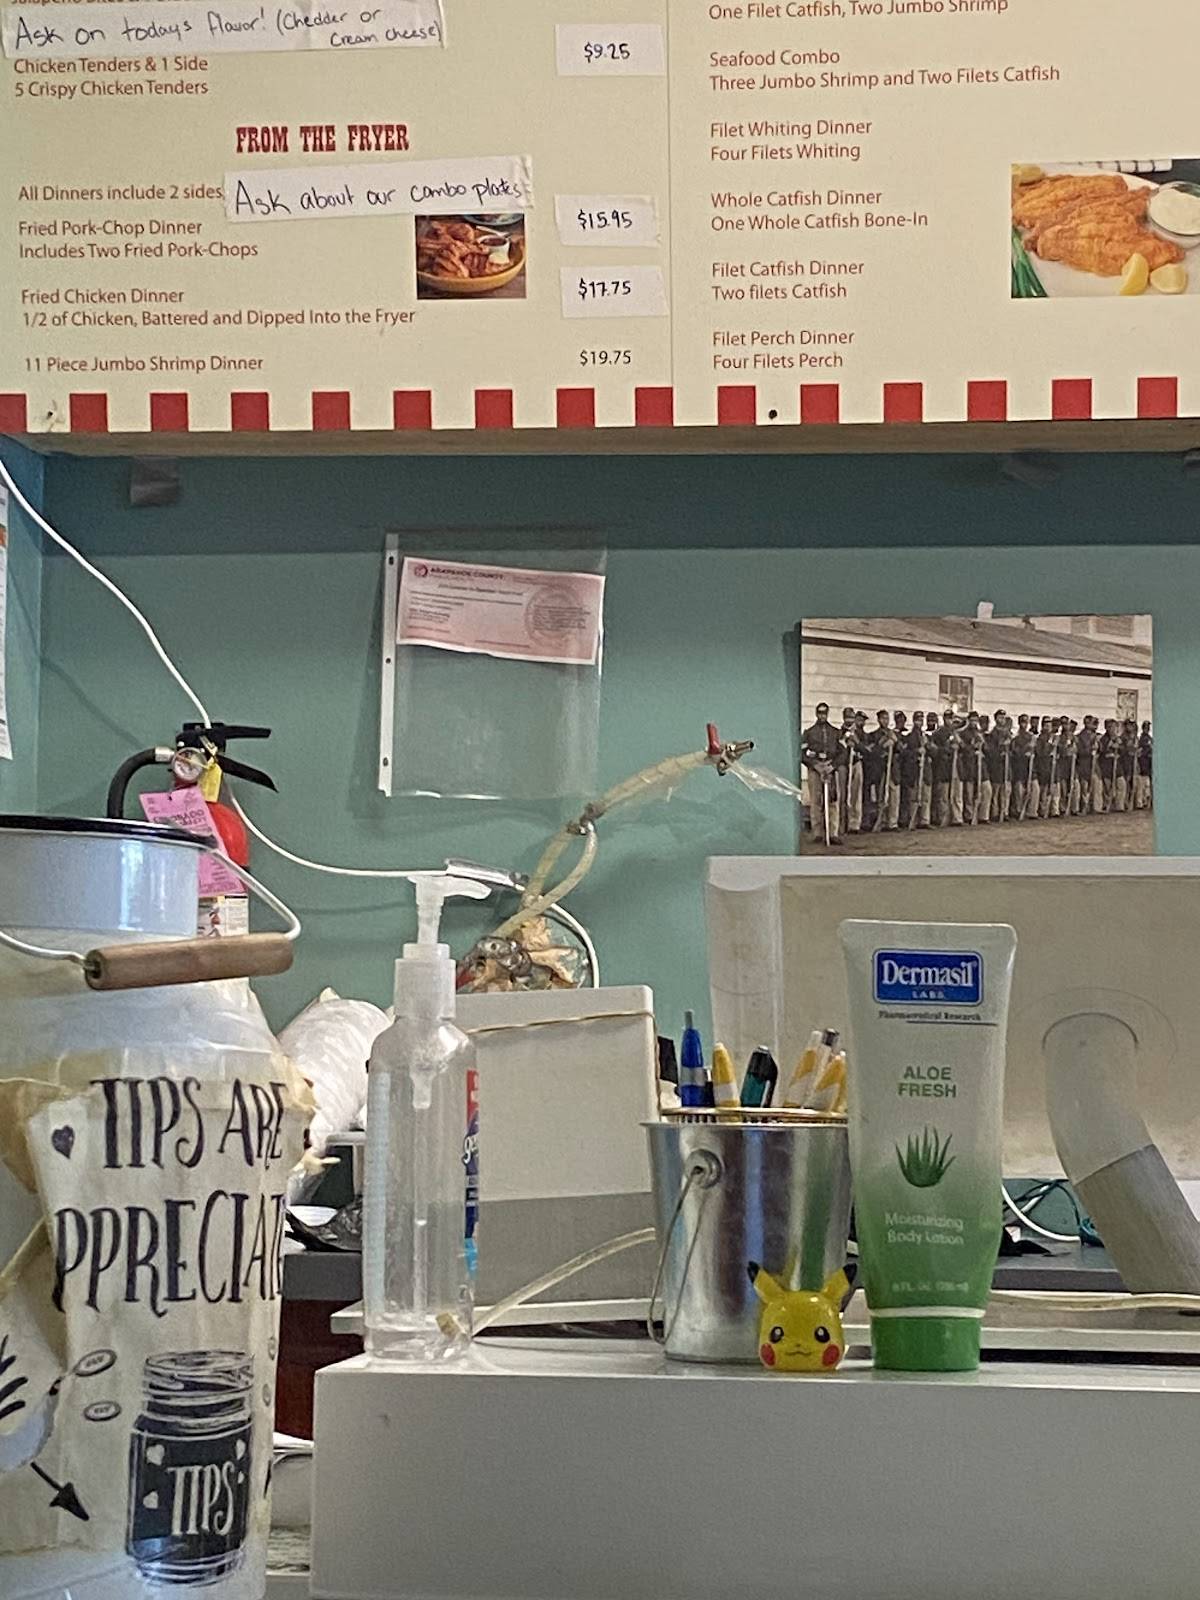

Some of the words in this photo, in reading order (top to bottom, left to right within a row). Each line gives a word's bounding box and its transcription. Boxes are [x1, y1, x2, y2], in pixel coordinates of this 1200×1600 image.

[709, 4, 743, 20] One
[747, 3, 782, 19] Filet
[785, 1, 846, 18] Catfish,
[849, 0, 884, 16] Two
[887, 0, 944, 15] Jumbo
[949, 0, 1009, 14] Shrimp
[15, 15, 65, 50] Ask
[75, 27, 106, 46] on
[121, 16, 193, 43] todays
[359, 9, 384, 23] or
[583, 42, 631, 63] $9.25
[709, 50, 776, 67] Seafood
[779, 48, 841, 66] Combo
[14, 57, 77, 75] Chicken
[78, 56, 141, 72] Tenders
[145, 55, 157, 71] &
[162, 55, 168, 70] 1
[174, 54, 209, 71] Side
[709, 74, 757, 91] Three
[758, 73, 816, 90] Jumbo
[819, 71, 880, 91] Shrimp
[882, 68, 915, 87] and
[917, 69, 952, 85] Two
[956, 66, 1000, 84] Filets
[1003, 64, 1061, 83] Catfish
[15, 82, 24, 97] 5
[27, 81, 77, 100] Crispy
[80, 79, 144, 96] Chicken
[145, 79, 209, 96] Tenders
[236, 126, 289, 153] FROM
[299, 125, 337, 152] THE
[346, 124, 410, 152] FRYER
[709, 121, 746, 138] Filet
[747, 119, 812, 140] Whiting
[815, 117, 873, 136] Dinner
[710, 144, 748, 161] Four
[750, 142, 794, 160] Filets
[795, 141, 861, 162] Whiting
[18, 185, 38, 201] All
[41, 184, 104, 200] Dinners
[107, 182, 167, 201] include
[169, 183, 180, 199] 2
[235, 179, 292, 215] Ask
[299, 185, 355, 210] about
[366, 188, 397, 206] our
[710, 192, 763, 208] Whole
[766, 190, 823, 207] Catfish
[826, 189, 883, 206] Dinner
[18, 220, 58, 236] Fried
[62, 218, 145, 239] Pork-Chop
[148, 220, 203, 236] Dinner
[710, 214, 746, 231] One
[748, 212, 801, 230] Whole
[803, 212, 860, 229] Catfish
[863, 211, 929, 228] Bone-In
[19, 242, 86, 260] Includes
[87, 242, 121, 259] Two
[124, 240, 164, 258] Fried
[168, 241, 260, 261] Pork-Chops
[711, 261, 746, 278] Filet
[749, 259, 806, 277] Catfish
[808, 259, 865, 276] Dinner
[21, 289, 60, 305] Fried
[63, 287, 127, 305] Chicken
[130, 288, 185, 304] Dinner
[578, 278, 632, 301] $17.75
[711, 284, 746, 301] Two
[748, 284, 790, 300] filets
[791, 283, 847, 300] Catfish
[22, 311, 48, 328] 1/2
[51, 310, 68, 328] of
[70, 309, 138, 328] Chicken,
[141, 308, 209, 326] Battered
[212, 308, 244, 326] and
[246, 307, 306, 329] Dipped
[309, 308, 342, 325] Into
[345, 306, 373, 324] the
[375, 306, 416, 326] Fryer
[712, 331, 747, 347] Filet
[750, 329, 796, 346] Perch
[799, 328, 855, 346] Dinner
[24, 355, 42, 372] 11
[46, 354, 90, 373] Piece
[90, 353, 146, 373] Jumbo
[149, 352, 207, 375] Shrimp
[209, 352, 265, 371] Dinner
[579, 350, 633, 366] $19.75
[712, 353, 749, 370] Four
[752, 353, 795, 369] Filets
[798, 352, 844, 369] Perch
[881, 959, 974, 987] Dermasil
[903, 1065, 952, 1081] ALOE
[897, 1082, 957, 1099] FRESH
[217, 1078, 288, 1170] ARE
[167, 1460, 237, 1537] TIPS
